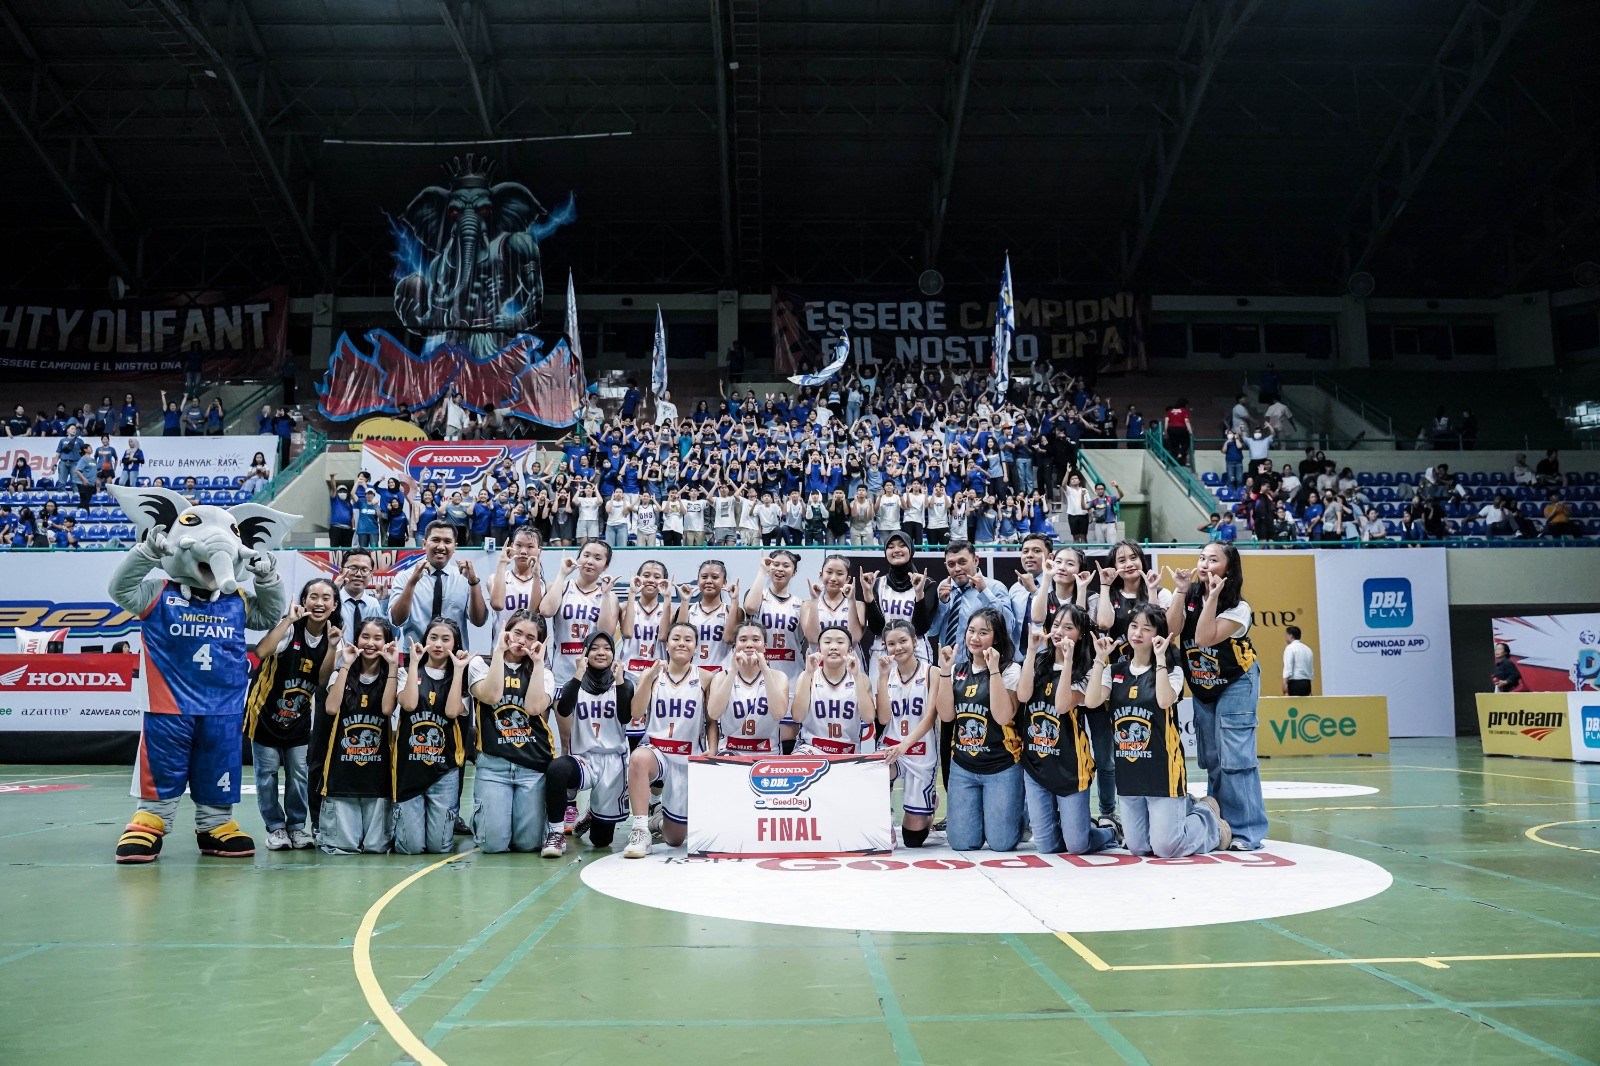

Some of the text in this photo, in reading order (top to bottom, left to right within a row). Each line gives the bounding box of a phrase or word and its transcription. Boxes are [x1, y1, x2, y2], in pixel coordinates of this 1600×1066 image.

[805, 301, 947, 331] ESSERE
[88, 302, 270, 353] OLIFANT
[853, 337, 882, 365] IL
[895, 334, 1039, 365] NOSTO
[40, 360, 91, 370] CAMPIONI
[103, 362, 111, 371] IL
[115, 361, 158, 371] NOSTRO
[160, 361, 182, 370] DNA
[148, 458, 238, 467] PERLU BANYAK RASA
[432, 455, 482, 463] HONDA
[882, 599, 915, 616] OHS
[1369, 591, 1408, 608] DBL
[563, 604, 600, 623] OHS
[1369, 608, 1407, 618] PLAY
[761, 613, 799, 632] OHS
[169, 623, 235, 639] OLIFANT
[571, 623, 589, 639] 97
[772, 633, 785, 648] 15
[1357, 639, 1425, 648] DOWNLOAD APP
[192, 644, 213, 671] 4
[640, 645, 655, 658] 24
[700, 645, 709, 659] 5
[1381, 648, 1402, 656] NOW
[27, 672, 126, 686] HONDA
[504, 675, 521, 689] 10
[1128, 685, 1139, 699] 6
[577, 700, 616, 720] OHS
[655, 698, 697, 719] OHS
[815, 700, 856, 720] OHS
[343, 714, 385, 728] OLIFANT
[1488, 709, 1563, 728] proteam
[592, 723, 600, 738] 7
[668, 722, 675, 738] 1
[827, 723, 842, 738] 10
[901, 720, 909, 736] 8
[217, 772, 231, 792] 4
[769, 778, 790, 788] DBL
[757, 817, 822, 841] FINAL
